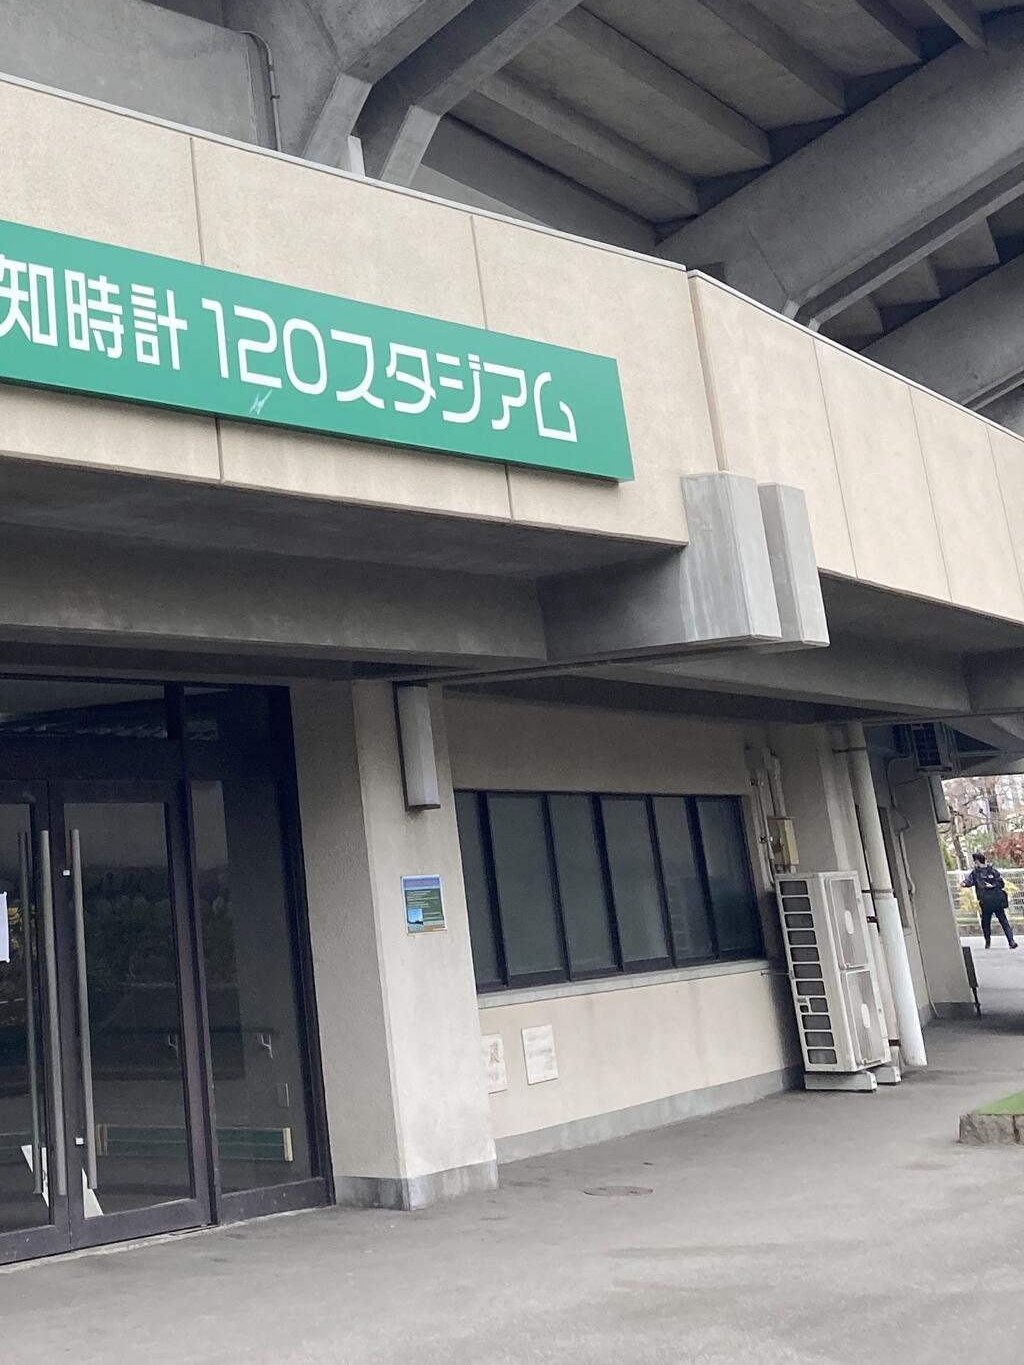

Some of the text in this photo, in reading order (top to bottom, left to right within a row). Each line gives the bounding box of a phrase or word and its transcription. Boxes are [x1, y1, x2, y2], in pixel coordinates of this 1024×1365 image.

[201, 298, 578, 442] 120スタジアム
